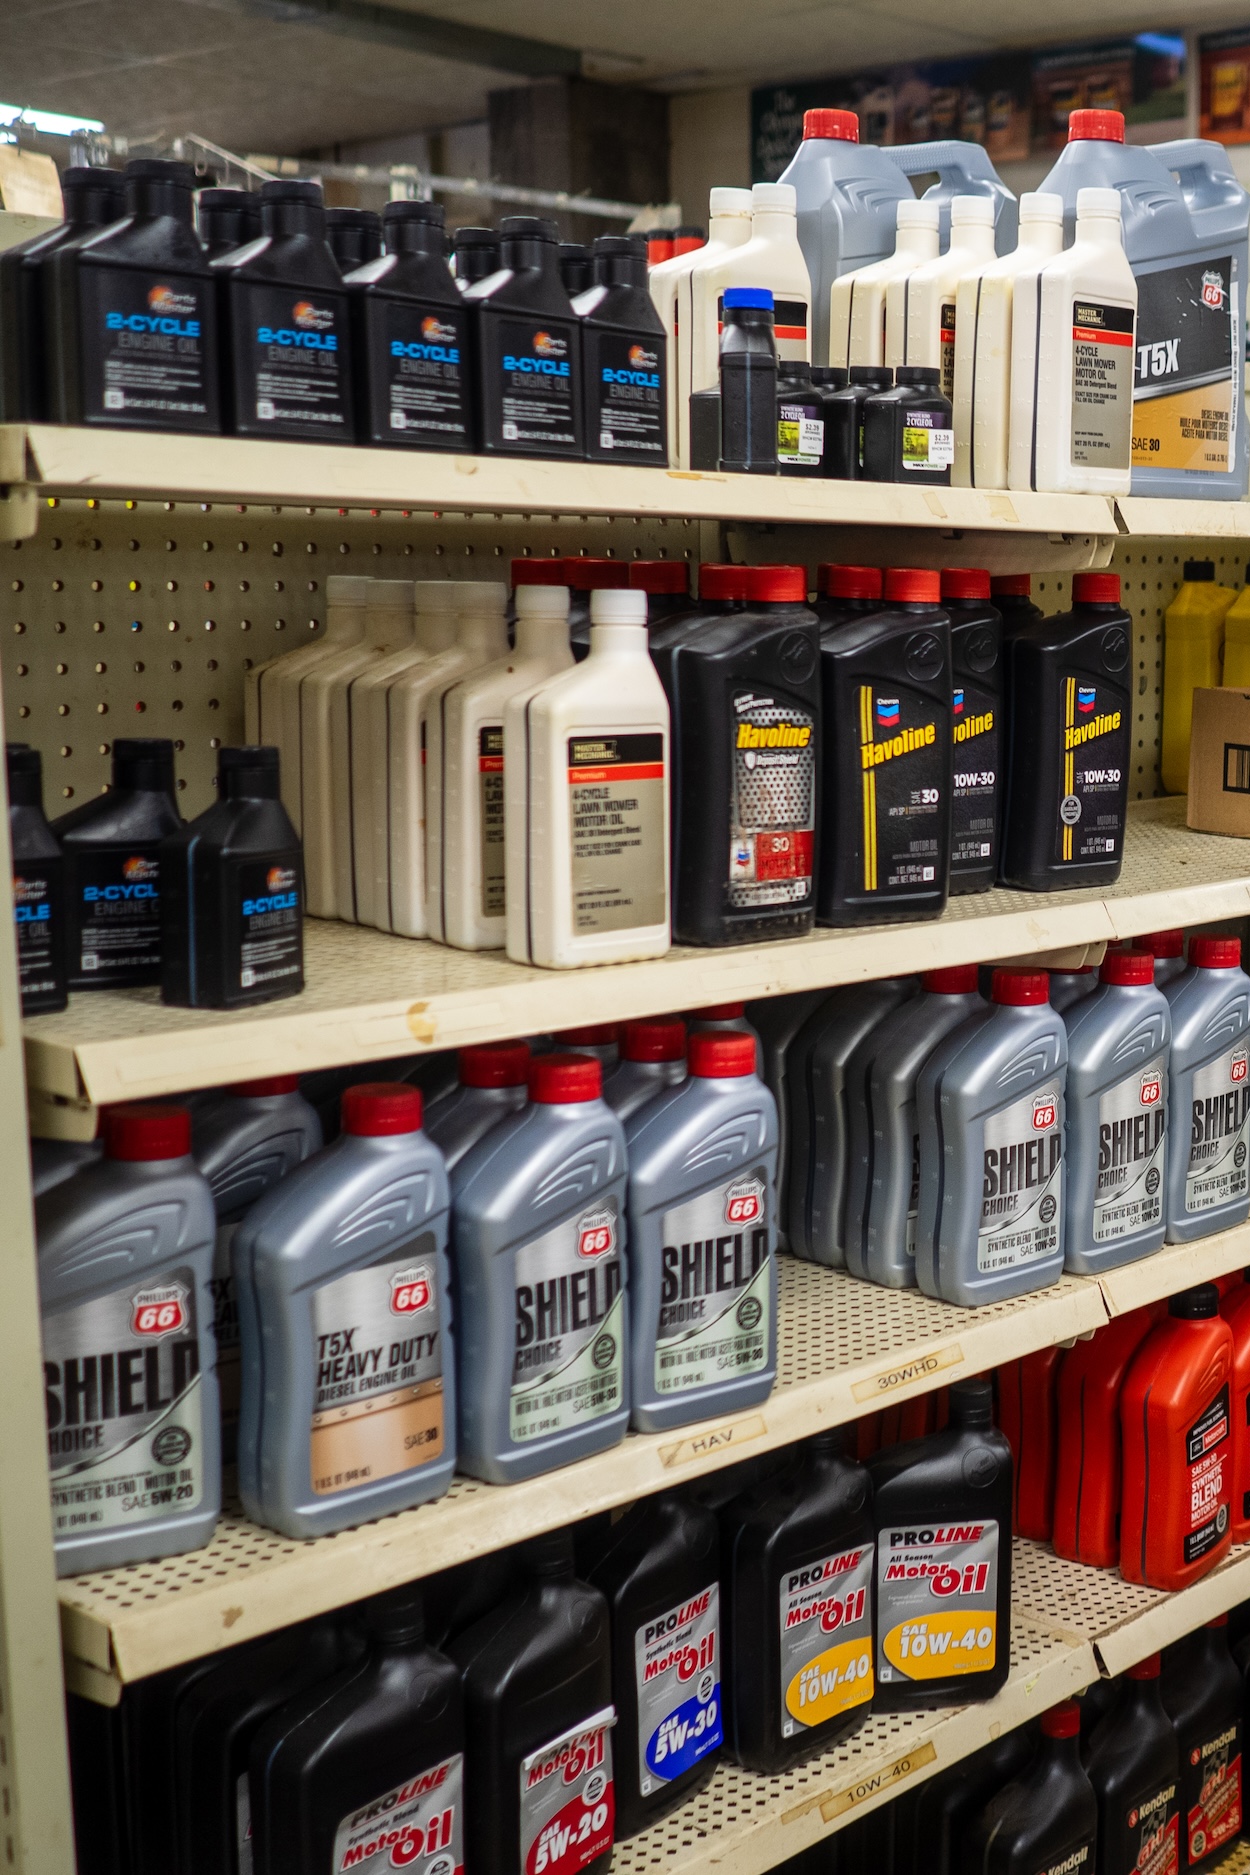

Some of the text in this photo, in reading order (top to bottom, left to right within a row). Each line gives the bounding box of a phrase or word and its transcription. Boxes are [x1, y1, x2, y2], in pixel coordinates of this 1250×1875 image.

[1077, 308, 1097, 316] MASTER
[1077, 315, 1102, 324] MECHANIC
[106, 312, 201, 337] 2-CYCLE
[1075, 330, 1097, 341] Premium
[118, 331, 174, 351] ENGINE
[257, 327, 338, 350] 2-CYCLE
[391, 340, 460, 364] 2-CYCLE
[1075, 345, 1098, 357] 4-CYCLE
[1137, 338, 1180, 379] T5X
[503, 356, 570, 377] 2-CYCLE
[1075, 357, 1116, 371] LAWN MOWER
[1075, 368, 1107, 380] MOTOR OIL
[602, 368, 660, 388] 2-CYCLE
[1149, 439, 1160, 451] 30
[736, 723, 811, 748] Havoline
[1065, 710, 1121, 750] Havoline
[861, 722, 936, 770] Havoline
[954, 772, 995, 787] 10W-30
[1084, 769, 1121, 783] 10W-30
[922, 789, 939, 803] 30
[771, 837, 790, 852] 30
[83, 884, 159, 902] 2-CYCL
[242, 892, 298, 916] 2-CYCLE
[1232, 1062, 1247, 1079] 66
[1035, 1097, 1055, 1108] PHILLIPS
[1142, 1084, 1158, 1100] 66
[1035, 1108, 1053, 1125] 66
[1191, 1141, 1219, 1161] CHOICE
[1098, 1166, 1127, 1188] CHOICE
[730, 1198, 755, 1219] 66
[983, 1194, 1018, 1217] CHOICE
[1102, 1209, 1125, 1223] SYNTHETIC
[582, 1229, 607, 1253] 66
[988, 1233, 1031, 1253] SYNTHETIC BLEND
[1020, 1236, 1056, 1257] SAE 10W-30
[394, 1270, 426, 1285] PHILLIPS
[137, 1289, 179, 1306] PHILLIPS
[396, 1285, 425, 1309] 66
[139, 1304, 177, 1330] 66
[659, 1299, 707, 1327] CHOICE
[318, 1327, 356, 1361] T5X
[317, 1331, 440, 1388] HEAVY DUTY
[515, 1340, 563, 1372] CHOICE
[318, 1366, 417, 1404] DIESEL ENGINE OIL
[878, 1358, 938, 1389] 30WHD
[691, 1429, 735, 1453] HAV
[1204, 1424, 1226, 1446] Motorcraft
[1203, 1453, 1218, 1470] 5W-30
[106, 1479, 138, 1498] BLEND
[1191, 1462, 1223, 1493] SYNTHETIC
[151, 1484, 193, 1506] 5W-20
[1191, 1475, 1223, 1510] BLEND
[1191, 1498, 1219, 1522] MOTOR OIL
[890, 1525, 984, 1548] PROLINE
[890, 1553, 933, 1563] All Season
[788, 1550, 863, 1592] PROLINE
[884, 1561, 949, 1583] Motor
[788, 1590, 823, 1610] All Season
[645, 1591, 711, 1645] PROLINE
[784, 1598, 836, 1631] Motor
[901, 1624, 928, 1636] SAE
[645, 1628, 693, 1661] Synthetic Blend
[899, 1627, 993, 1659] 10W-40
[643, 1645, 690, 1685] Motor
[799, 1665, 820, 1684] SAE
[797, 1654, 870, 1708] 10W-40
[654, 1701, 717, 1764] 5W-30
[658, 1715, 680, 1738] SAE
[1202, 1726, 1237, 1759] Kendall
[526, 1747, 577, 1789] Motor
[847, 1760, 911, 1804] 10W-40
[350, 1764, 450, 1828] PROLINE
[1139, 1785, 1176, 1820] Kendall
[393, 1804, 420, 1822] Blend
[534, 1803, 608, 1875] 5W-20
[539, 1820, 561, 1842] SAE
[341, 1822, 413, 1872] Motor
[1048, 1846, 1089, 1875] Kendall
